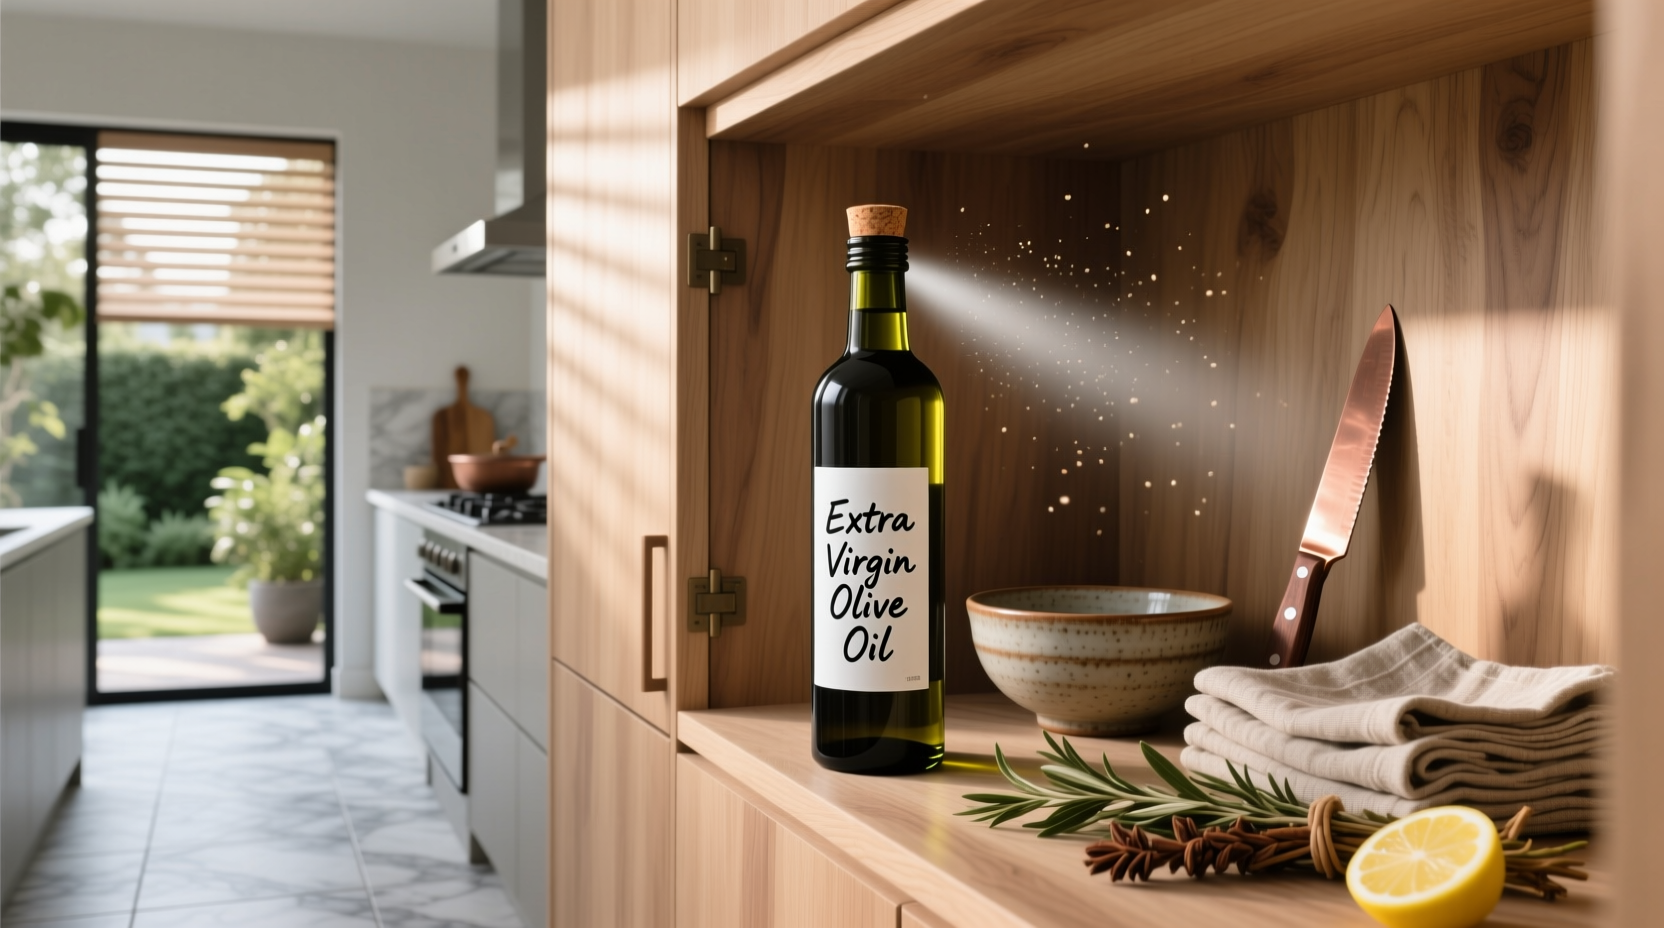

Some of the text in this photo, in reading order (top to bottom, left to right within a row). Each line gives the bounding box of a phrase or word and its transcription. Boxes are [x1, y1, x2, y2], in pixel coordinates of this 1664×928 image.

[825, 498, 915, 534] Extra
[827, 541, 916, 589] Virgin
[830, 584, 908, 619] Olive
[843, 625, 894, 662] Oil
